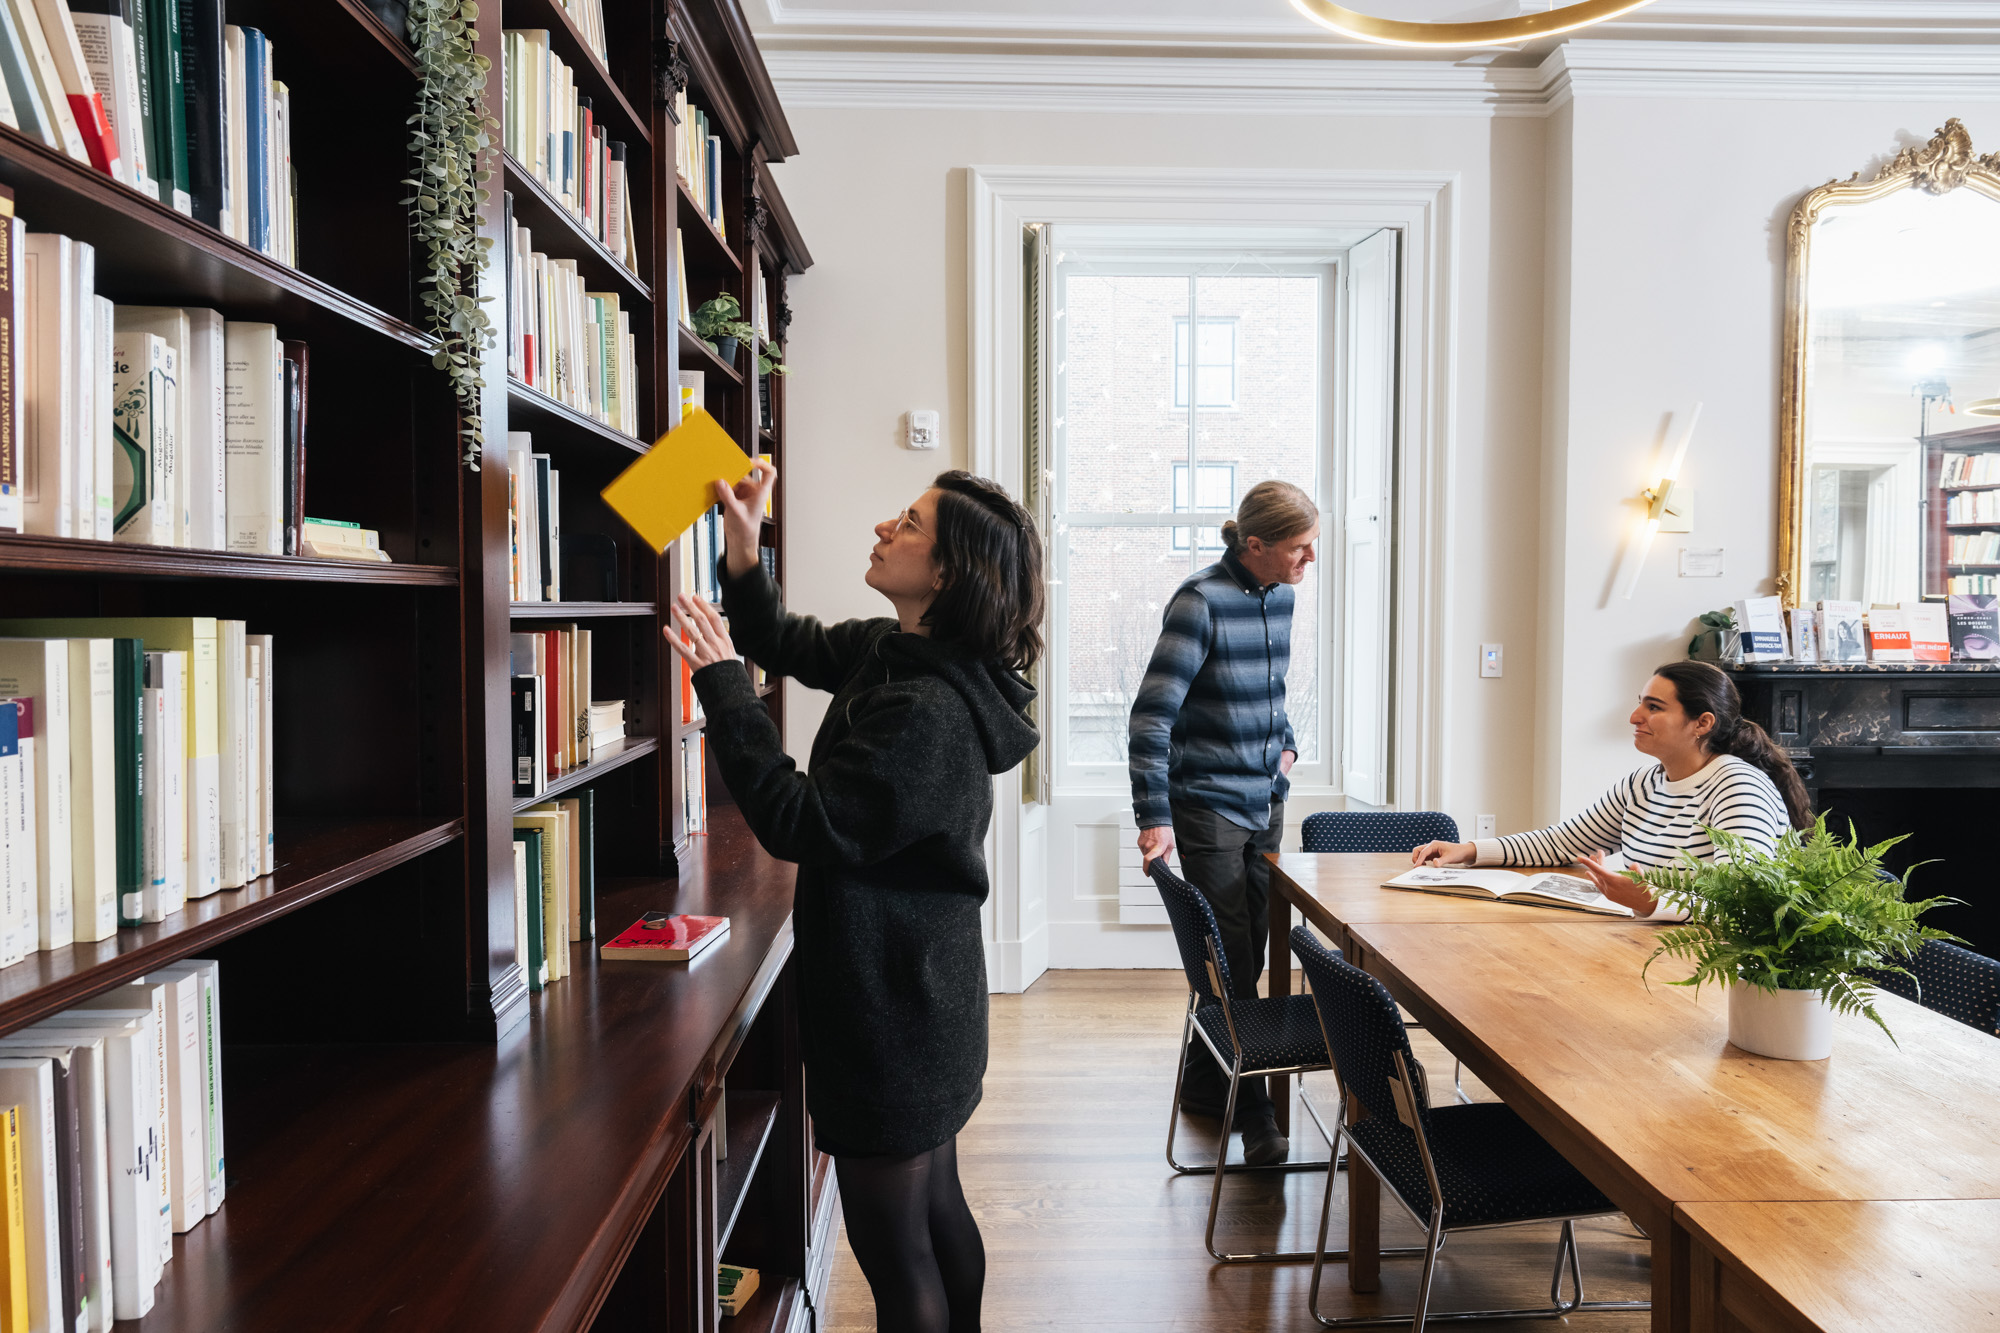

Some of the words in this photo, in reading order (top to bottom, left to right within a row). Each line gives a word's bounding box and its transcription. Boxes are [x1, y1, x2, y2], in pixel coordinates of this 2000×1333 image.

[0, 317, 9, 355] BLEUES
[1, 355, 9, 392] FLEURS
[2, 400, 10, 468] FLAMBOYANT
[2, 472, 10, 482] LE
[207, 1015, 212, 1023] LE
[159, 1086, 164, 1095] et
[209, 1082, 213, 1091] DE
